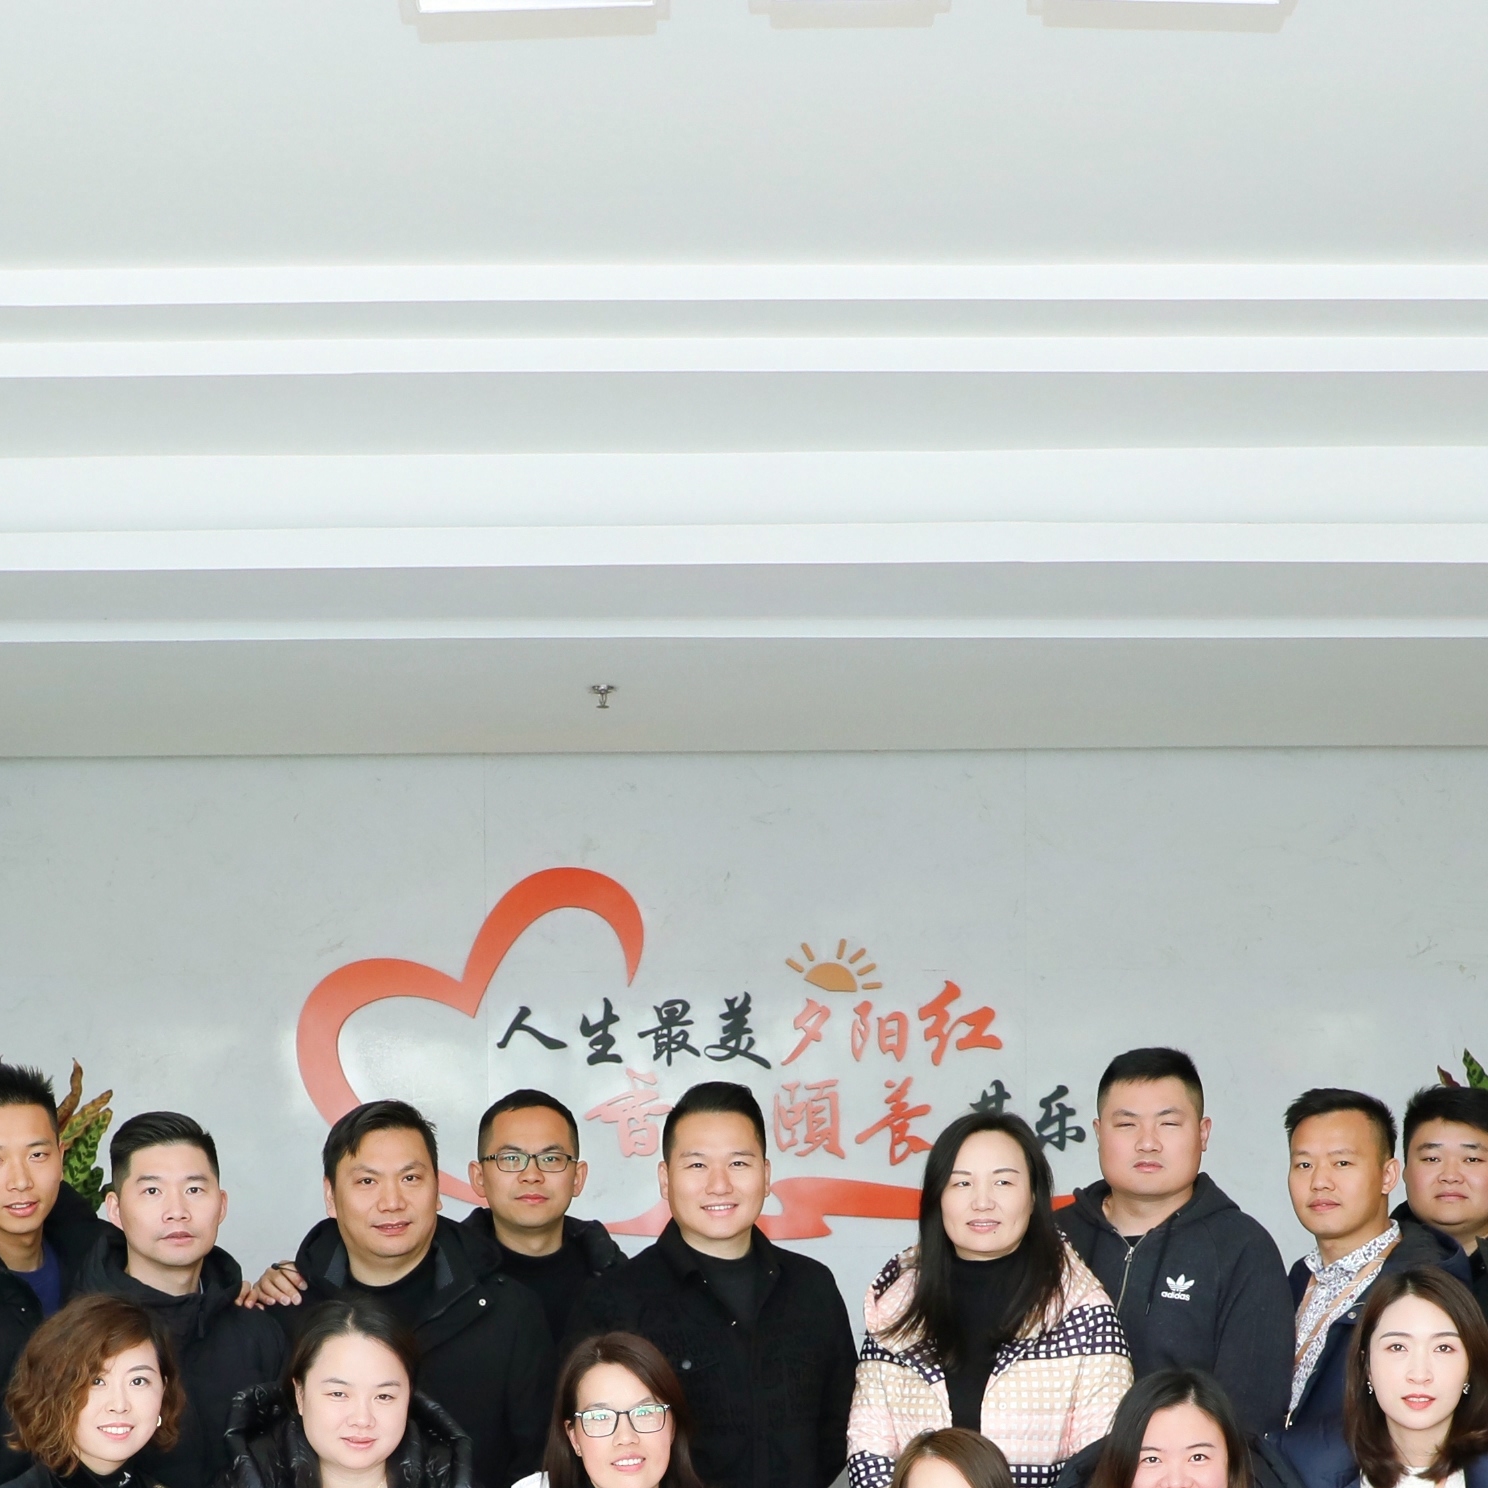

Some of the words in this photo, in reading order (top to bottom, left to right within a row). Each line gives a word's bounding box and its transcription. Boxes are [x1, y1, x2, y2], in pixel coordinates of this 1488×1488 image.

[497, 980, 1003, 1069] 人生最美夕阳红
[1161, 1290, 1191, 1302] adidas
